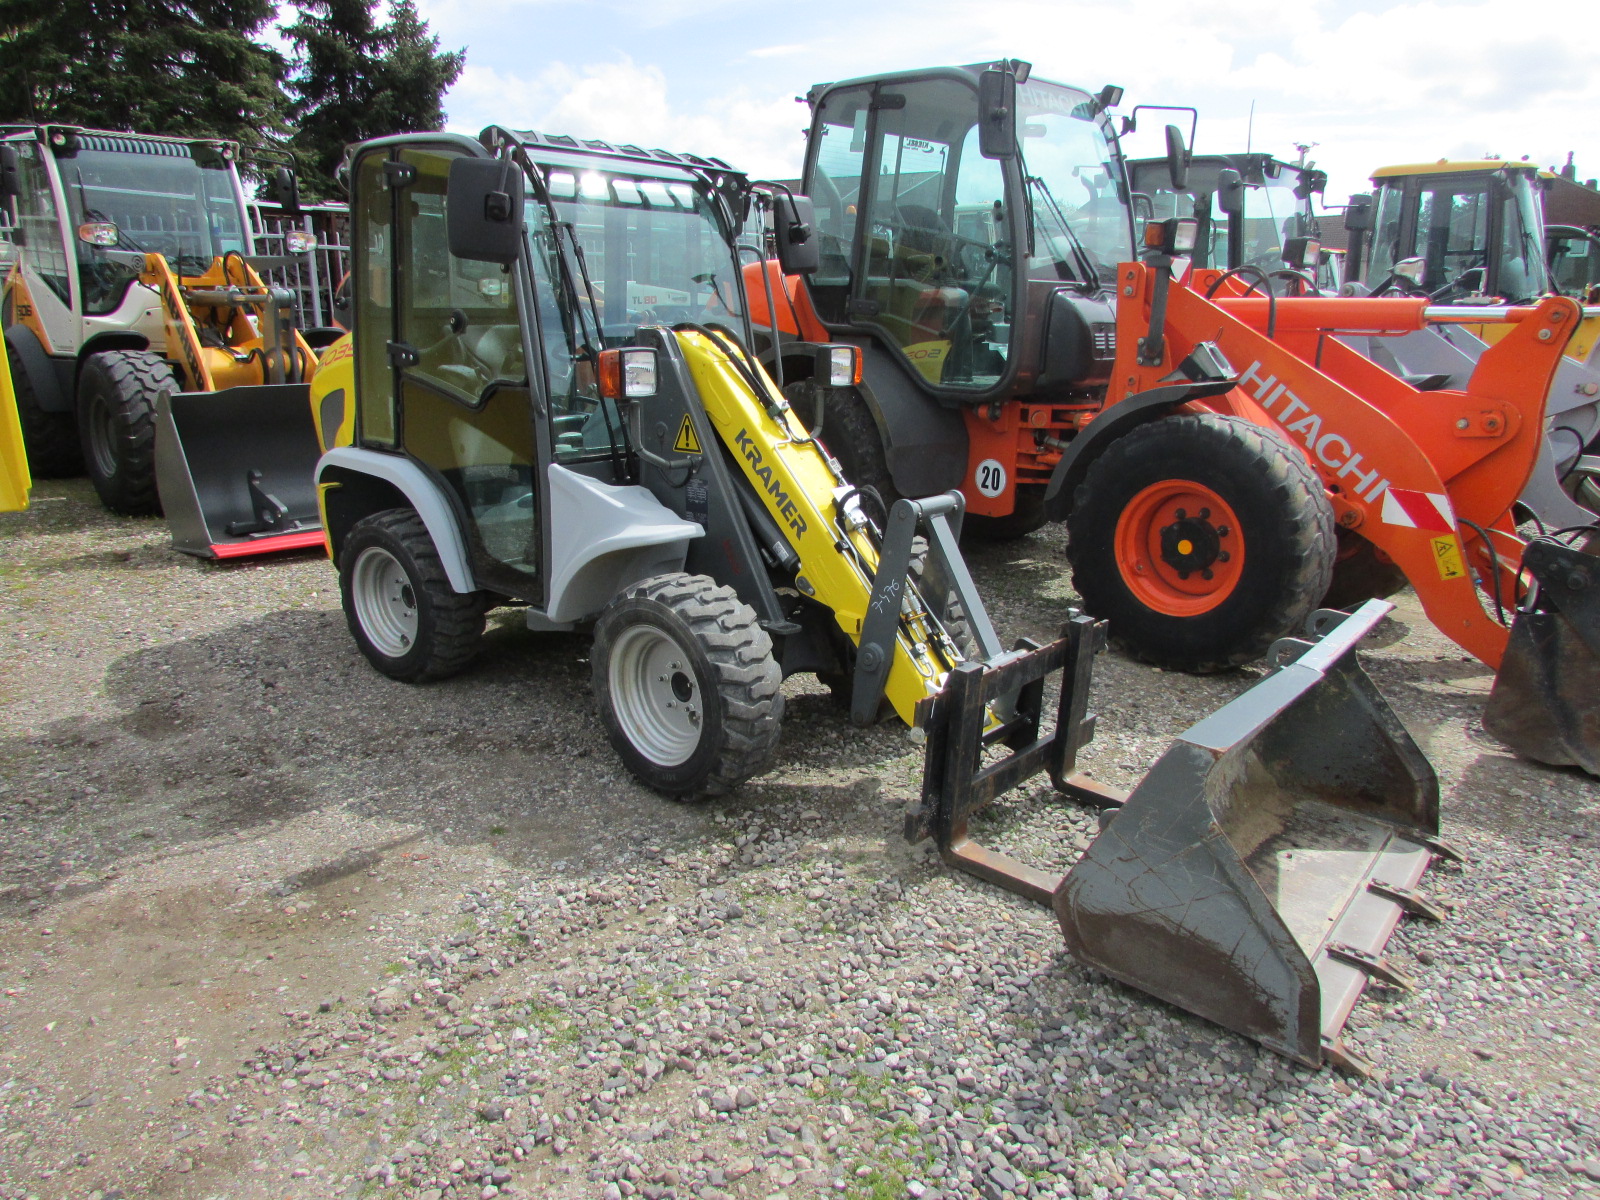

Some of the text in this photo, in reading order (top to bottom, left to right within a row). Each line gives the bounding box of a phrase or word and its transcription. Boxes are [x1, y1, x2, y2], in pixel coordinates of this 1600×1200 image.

[735, 428, 808, 541] KRAMER
[981, 465, 1001, 491] 20
[1239, 360, 1390, 504] HITACHI
